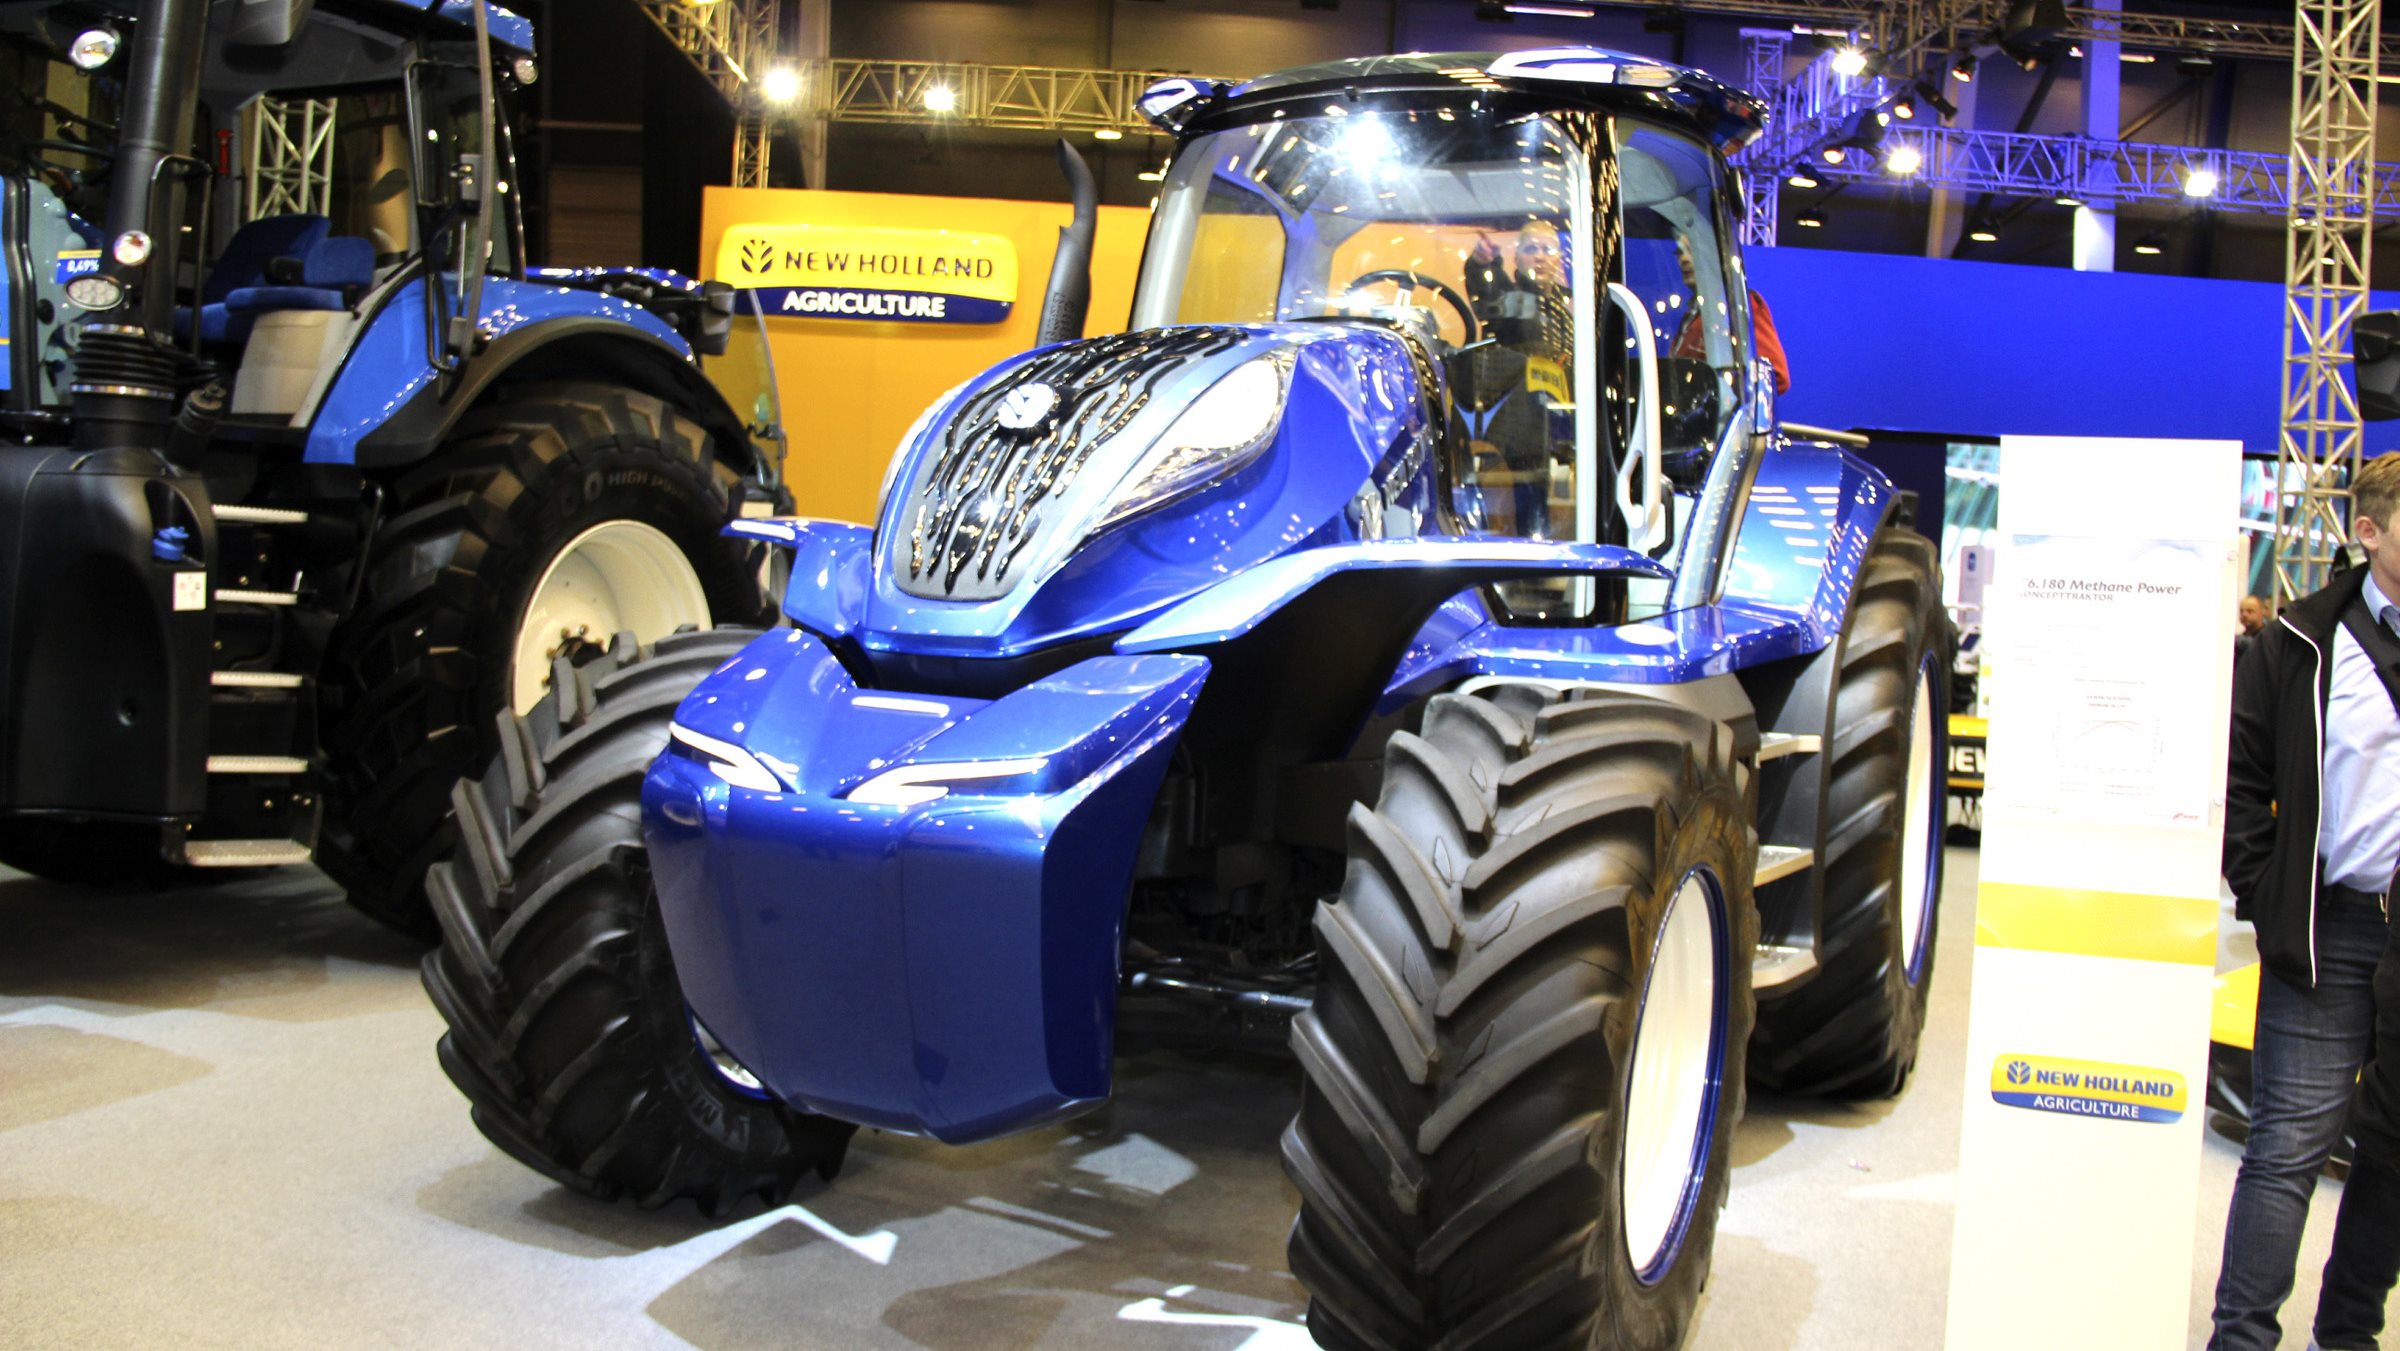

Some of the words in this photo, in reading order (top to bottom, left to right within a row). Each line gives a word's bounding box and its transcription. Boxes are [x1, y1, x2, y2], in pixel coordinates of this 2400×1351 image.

[785, 250, 848, 271] NEW
[859, 254, 993, 278] HOLLAND
[782, 290, 946, 318] AGRICULTURE
[2070, 579, 2133, 593] Methane
[2137, 582, 2182, 595] Power
[2036, 1070, 2080, 1087] NEW
[2084, 1074, 2174, 1098] HOLLAND
[2033, 1094, 2140, 1119] AGRICULTURE
